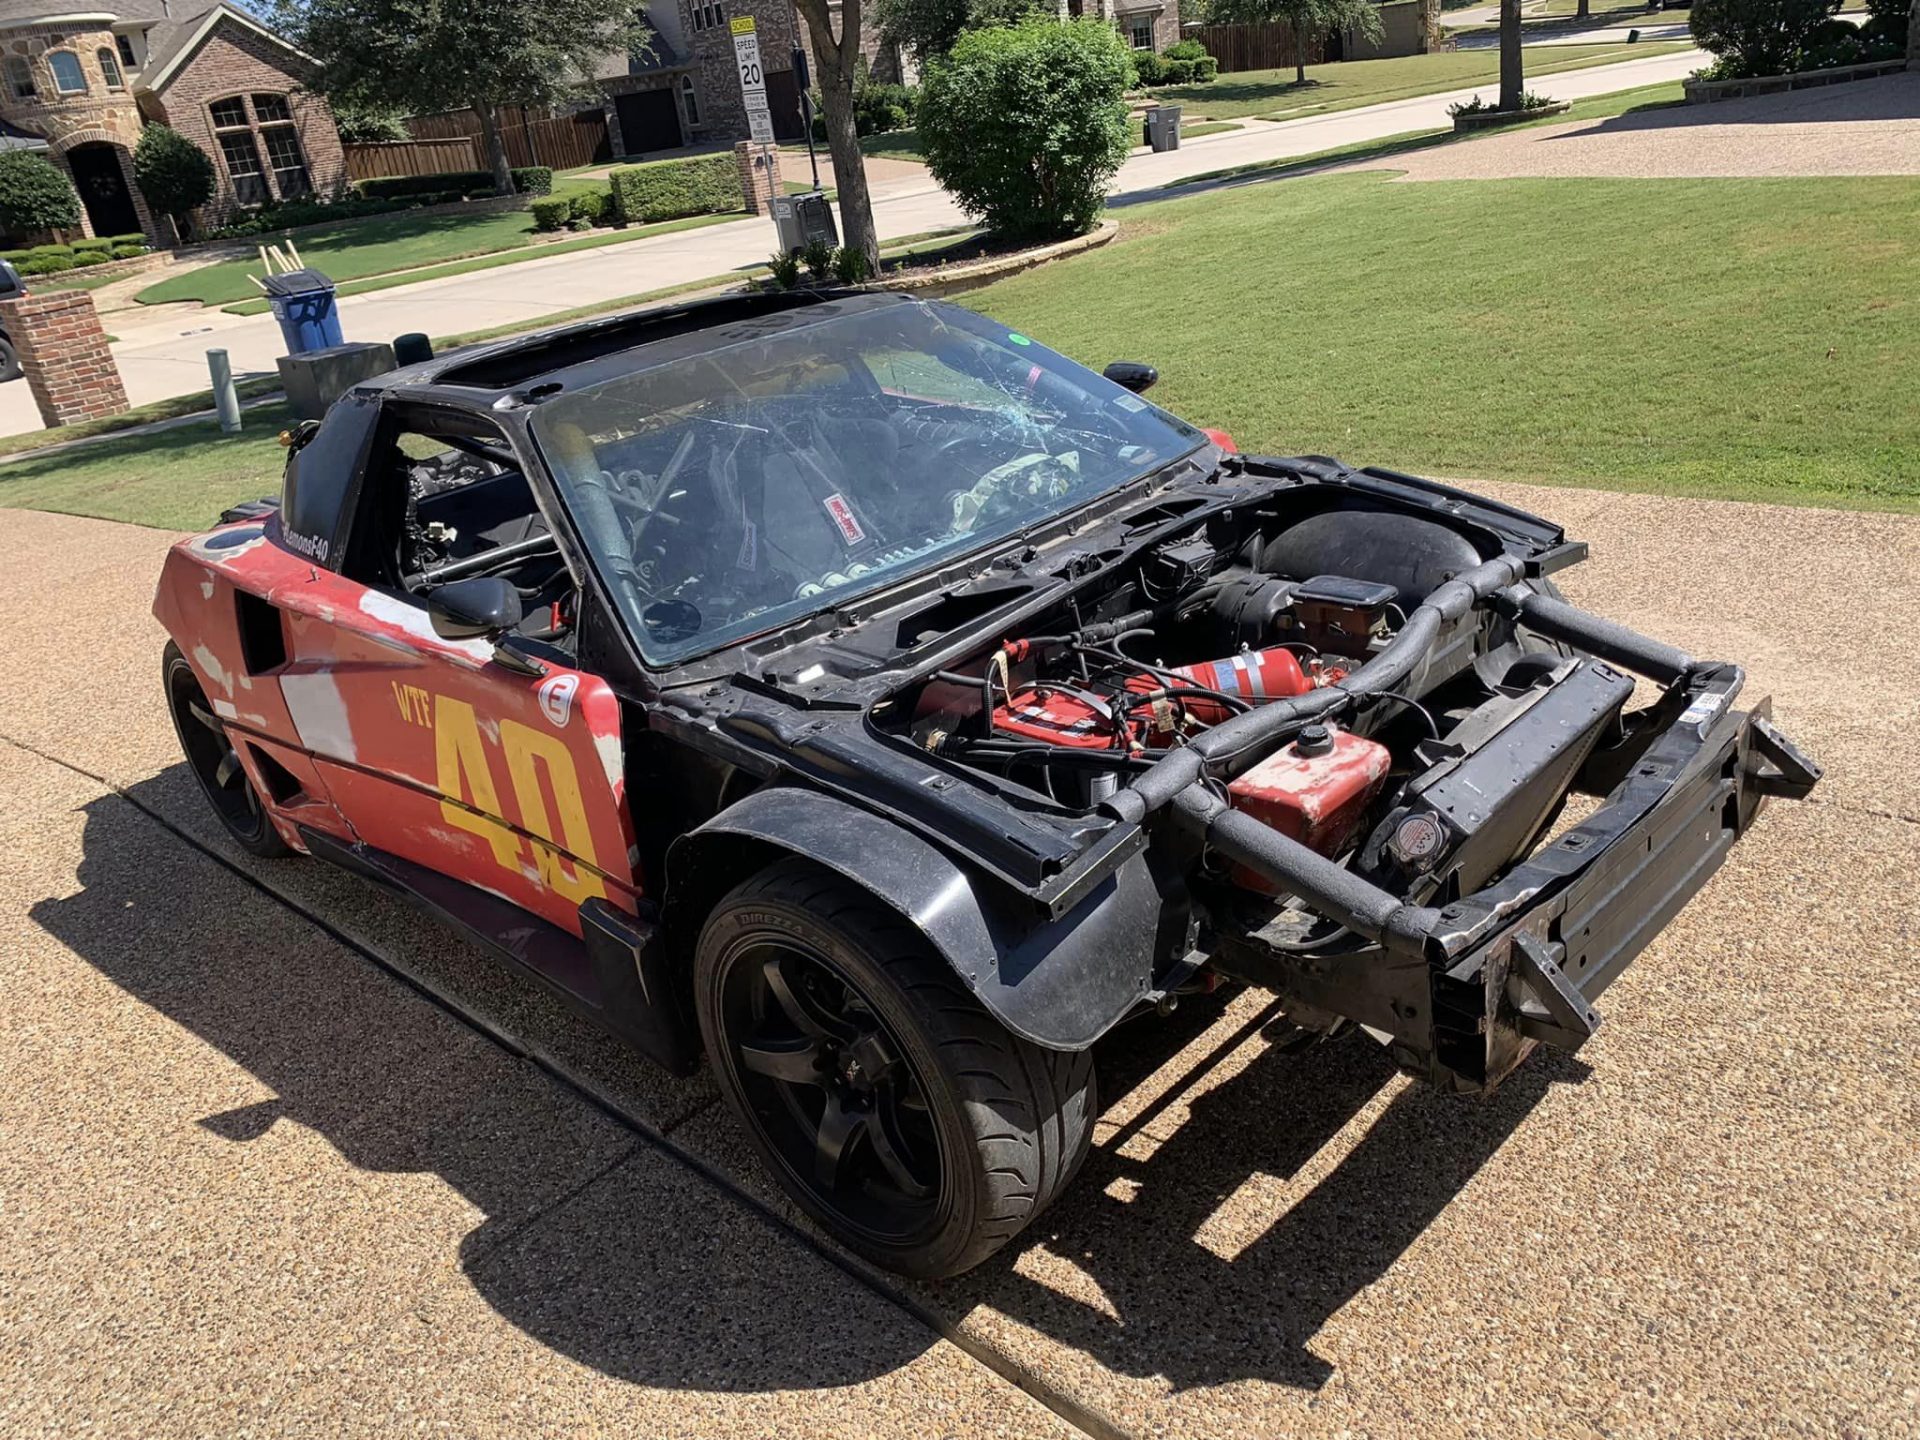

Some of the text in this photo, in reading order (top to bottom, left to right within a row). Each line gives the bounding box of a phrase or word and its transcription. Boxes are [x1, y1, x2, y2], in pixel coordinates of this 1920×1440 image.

[732, 20, 753, 30] SCHOOL
[737, 39, 755, 51] SPEED
[740, 51, 755, 62] LIMIT
[741, 63, 760, 85] 20
[549, 683, 568, 715] E
[391, 680, 607, 905] WTF 40
